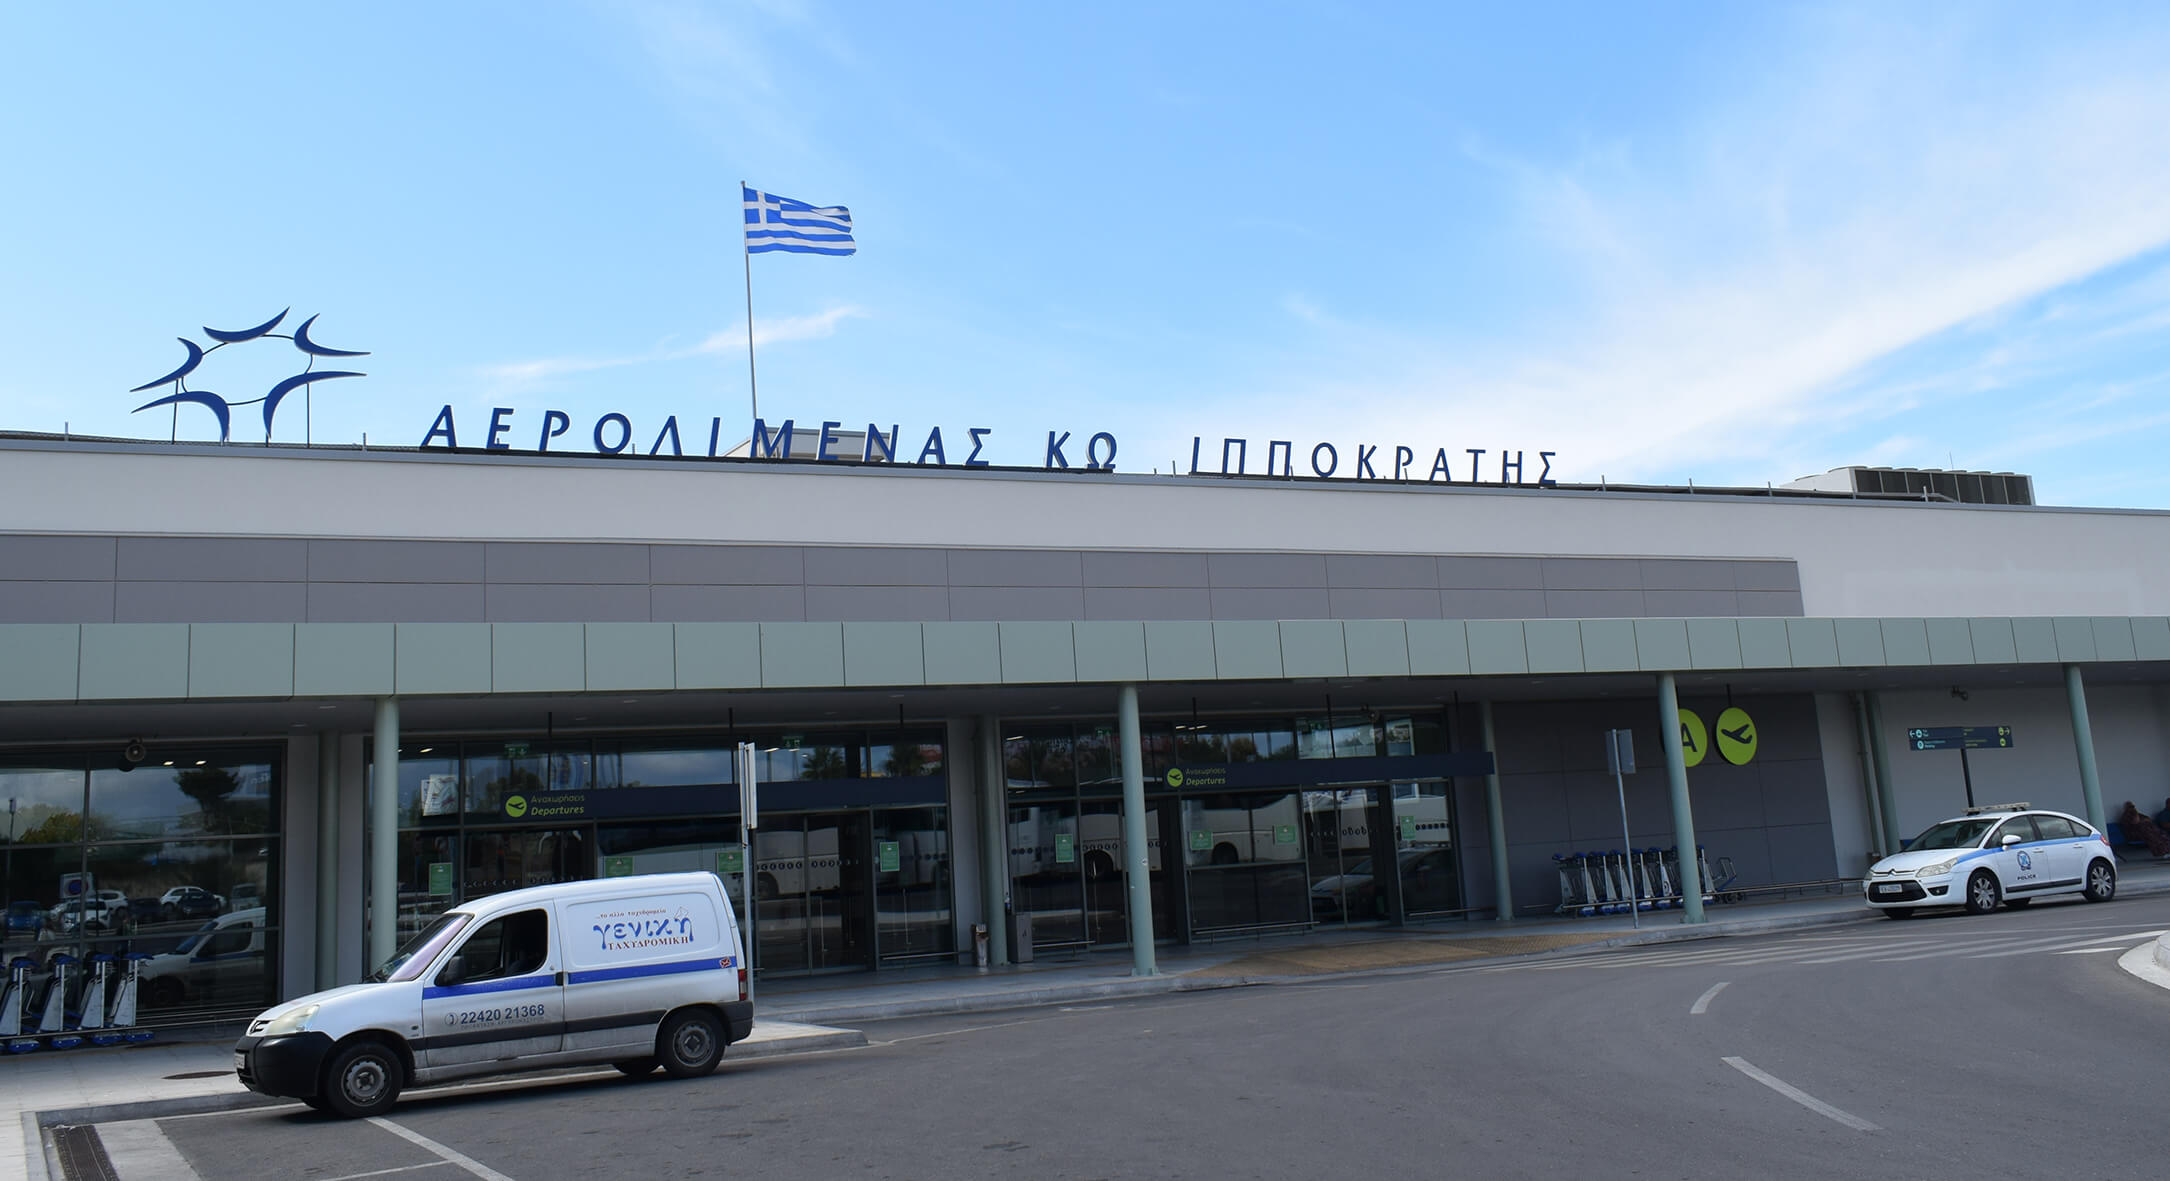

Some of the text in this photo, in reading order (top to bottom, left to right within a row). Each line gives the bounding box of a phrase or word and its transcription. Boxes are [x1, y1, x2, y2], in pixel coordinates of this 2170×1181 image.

[420, 404, 1557, 485] ΑΕΡΟΛΙΜΕΝΑΣ ΚΩ ΙΠΠΟΚΡΑΤΗΣ
[1185, 777, 1227, 786] Departures
[530, 806, 585, 817] Departures
[608, 936, 689, 950] ΤΑΧΥΔΡΟΜΙΚΗ
[460, 1008, 501, 1025] 22420
[505, 1004, 545, 1019] 21368
